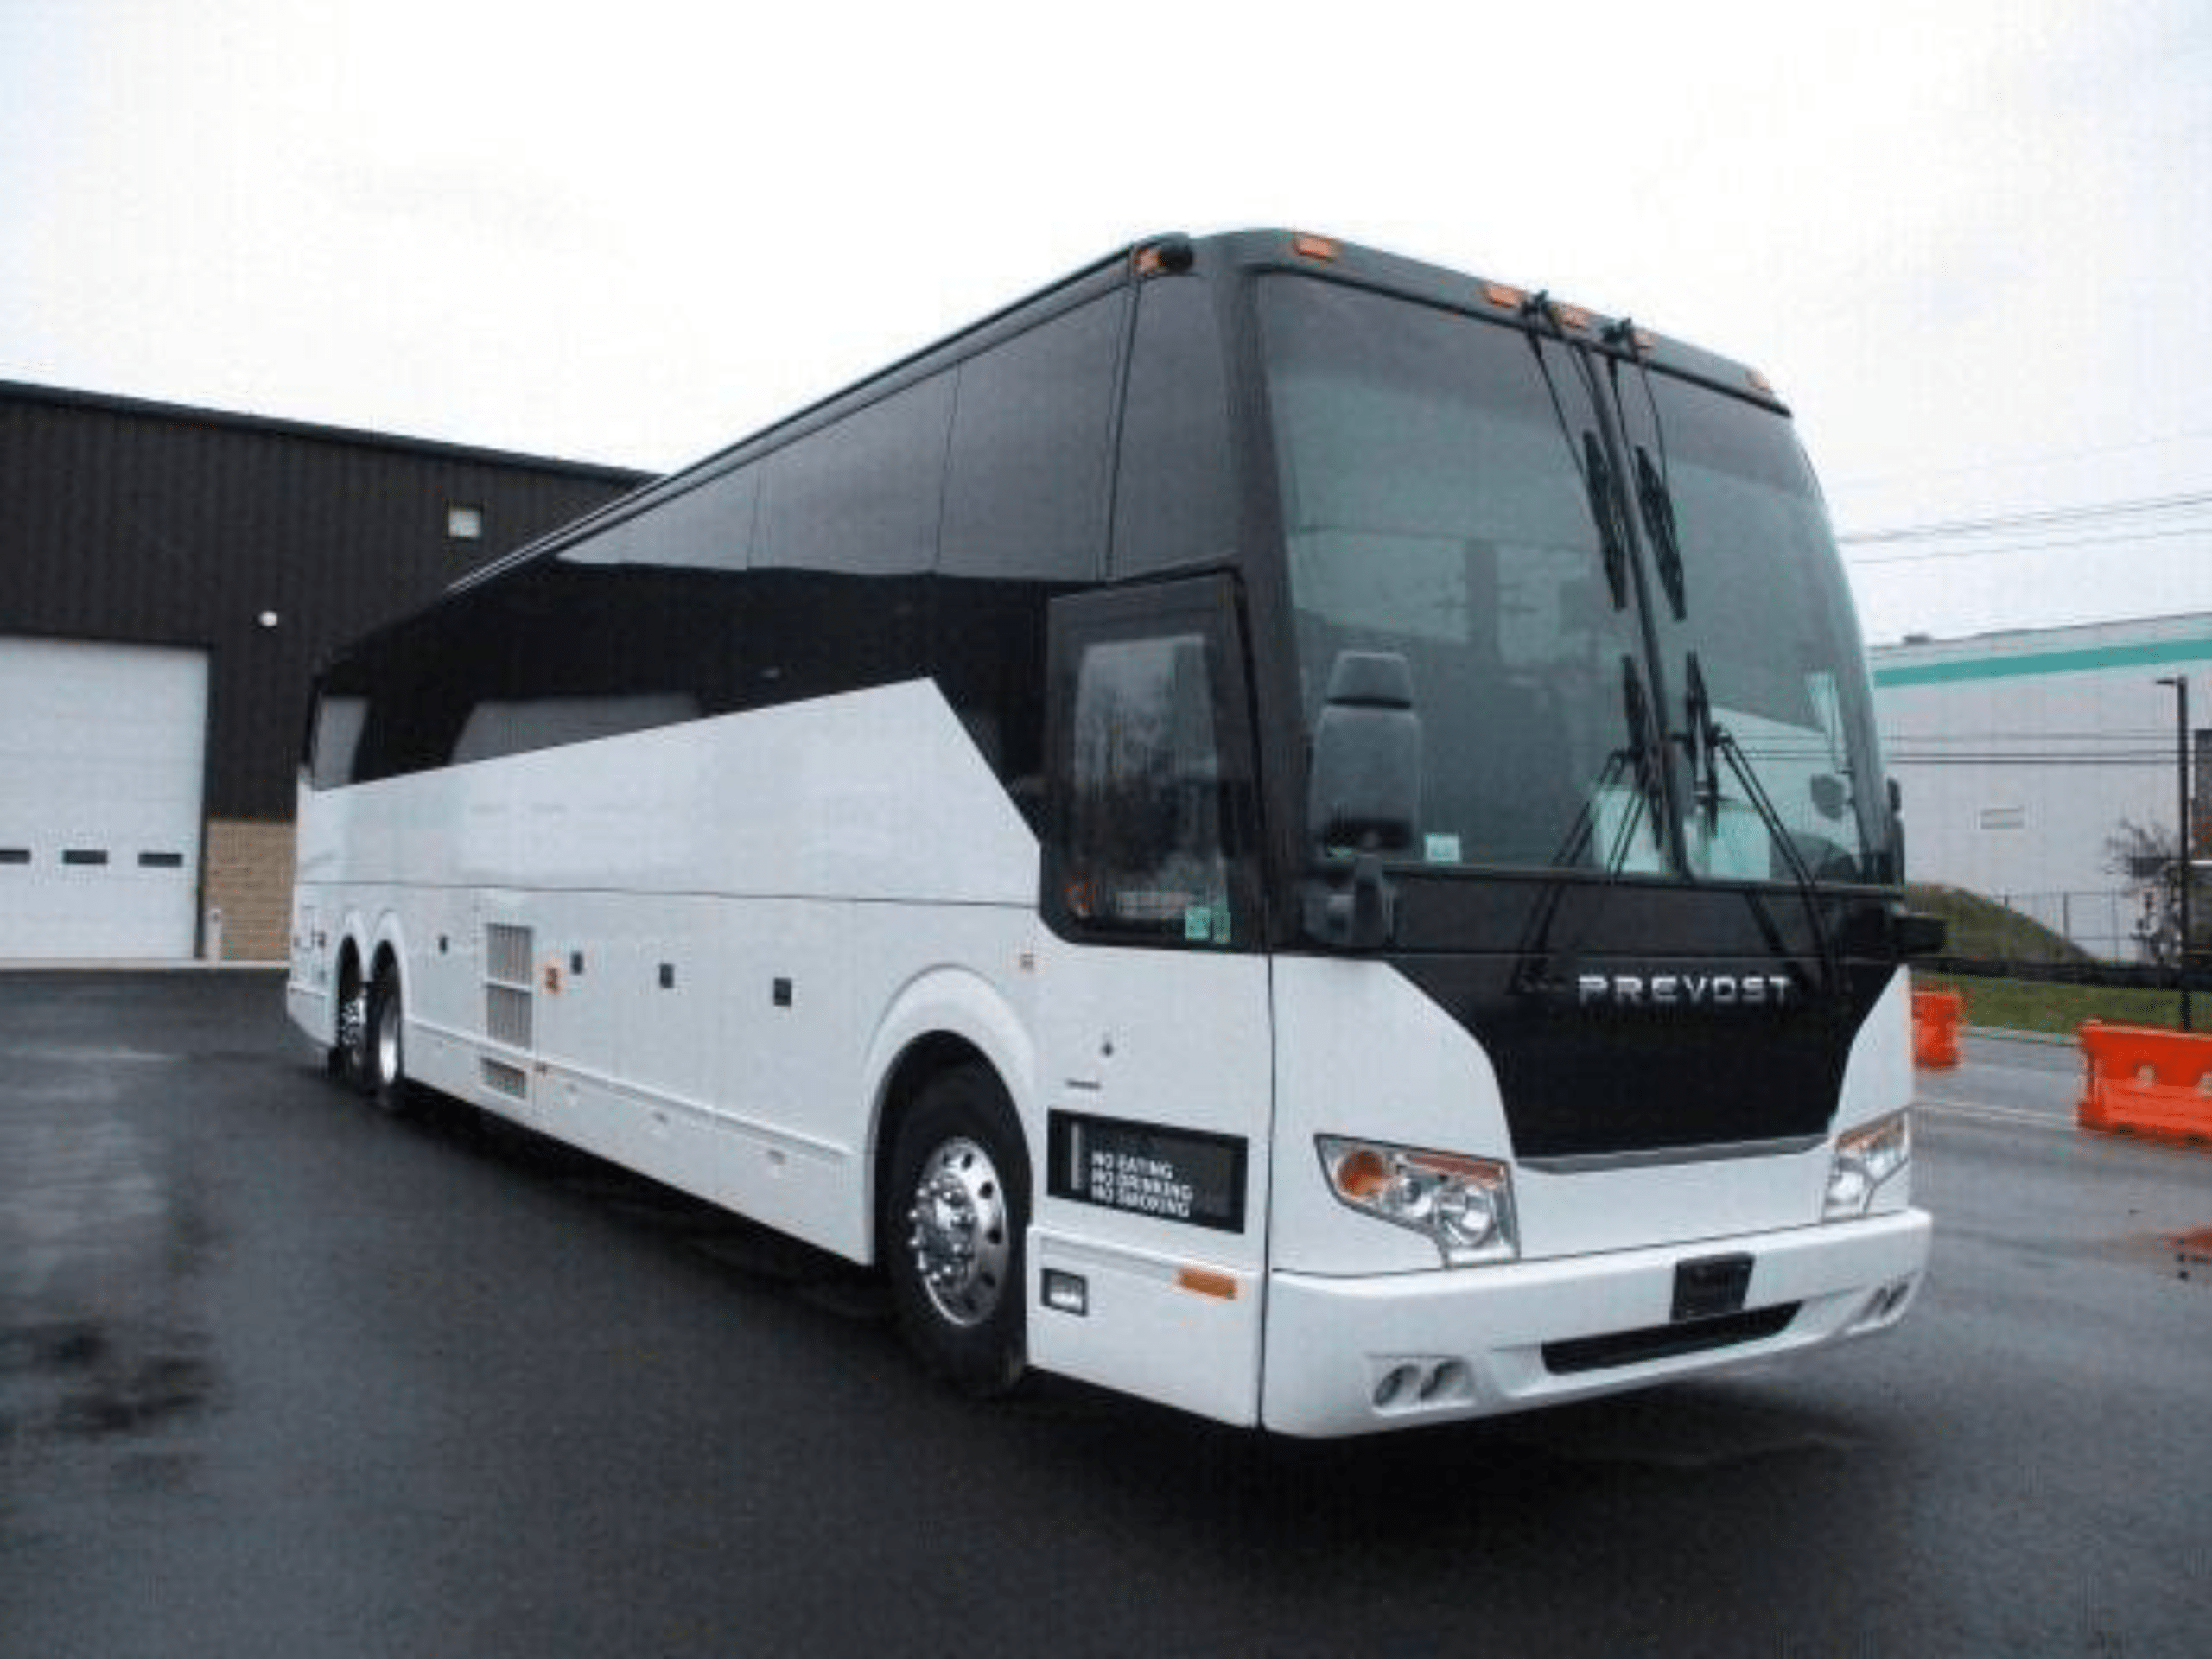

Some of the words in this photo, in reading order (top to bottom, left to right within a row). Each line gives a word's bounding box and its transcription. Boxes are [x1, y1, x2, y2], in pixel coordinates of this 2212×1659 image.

[1578, 974, 1790, 1005] PREVOST
[1091, 1150, 1114, 1171] NO
[1118, 1154, 1173, 1180] EATING
[1091, 1168, 1114, 1189] NO
[1118, 1174, 1193, 1202] DRINKING
[1091, 1185, 1114, 1204] NO
[1118, 1189, 1190, 1217] SMOKING
